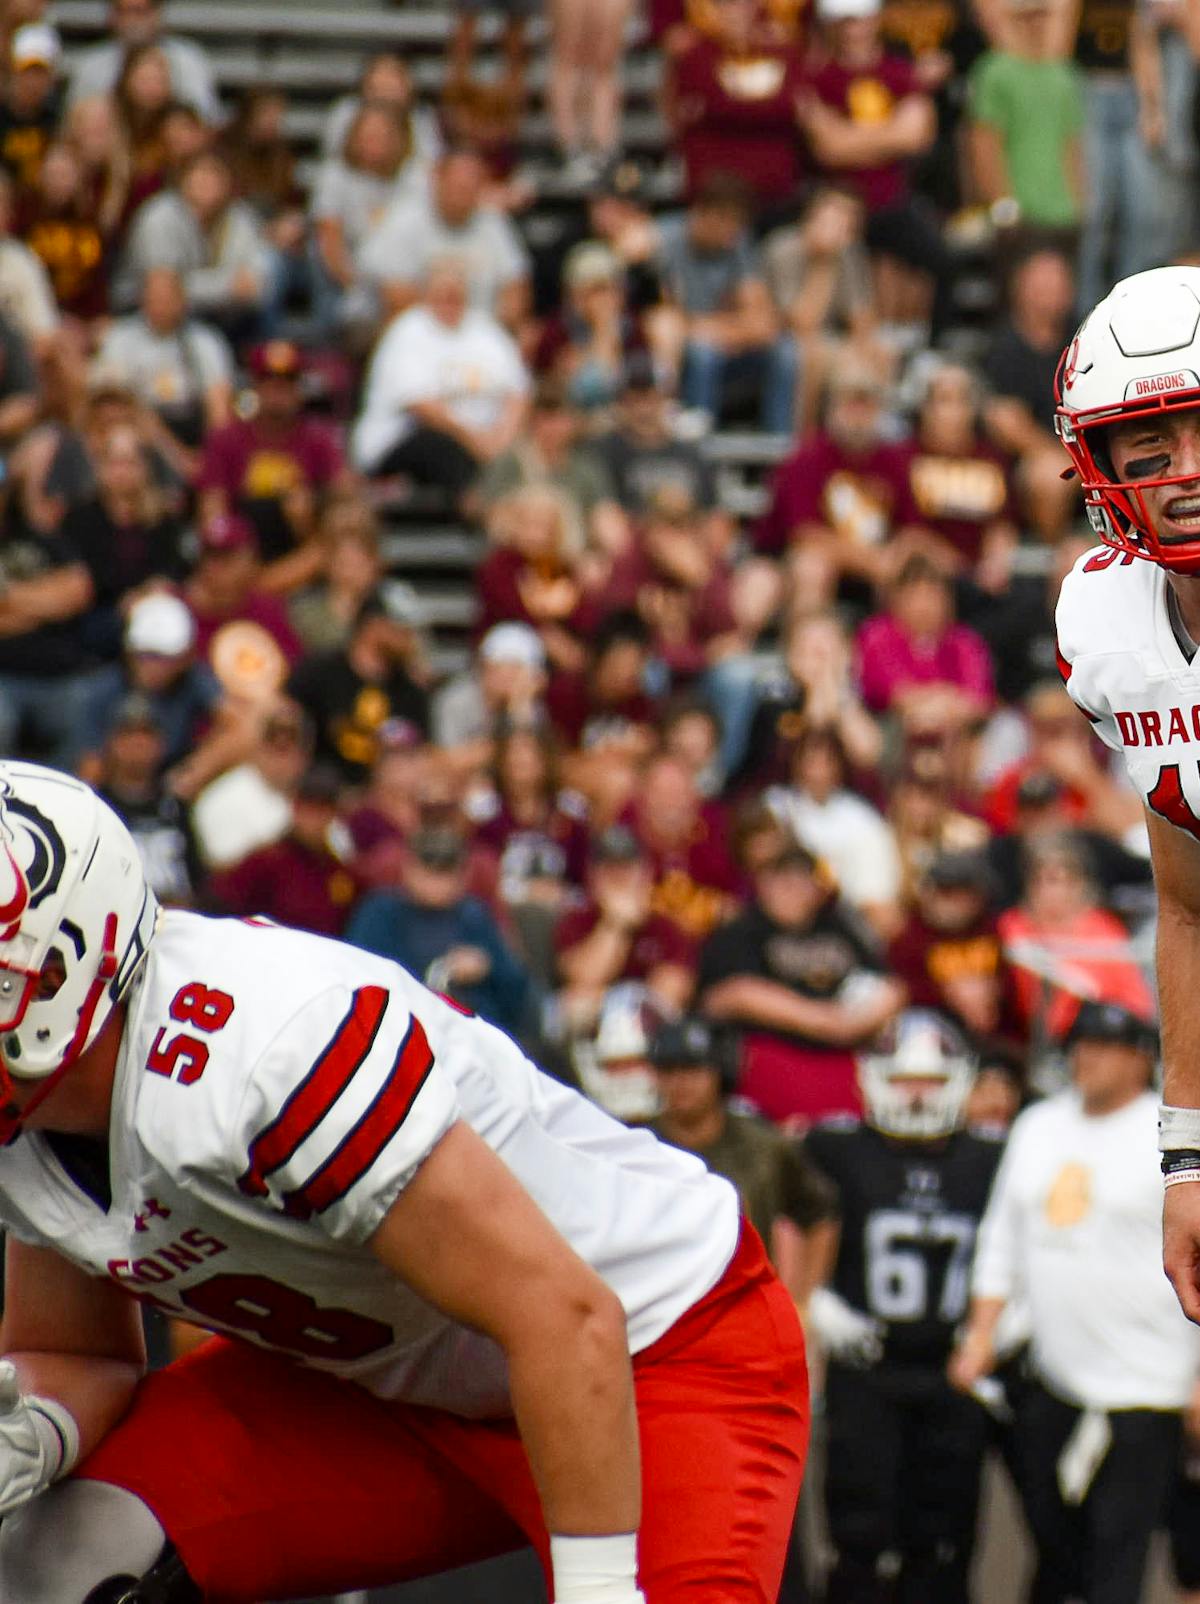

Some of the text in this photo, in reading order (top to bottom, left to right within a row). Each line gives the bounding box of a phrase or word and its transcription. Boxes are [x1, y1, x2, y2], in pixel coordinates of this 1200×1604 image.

[1136, 373, 1185, 395] DRAGONS
[145, 982, 234, 1086] 58
[865, 1208, 975, 1323] 67
[179, 1272, 395, 1362] 8
